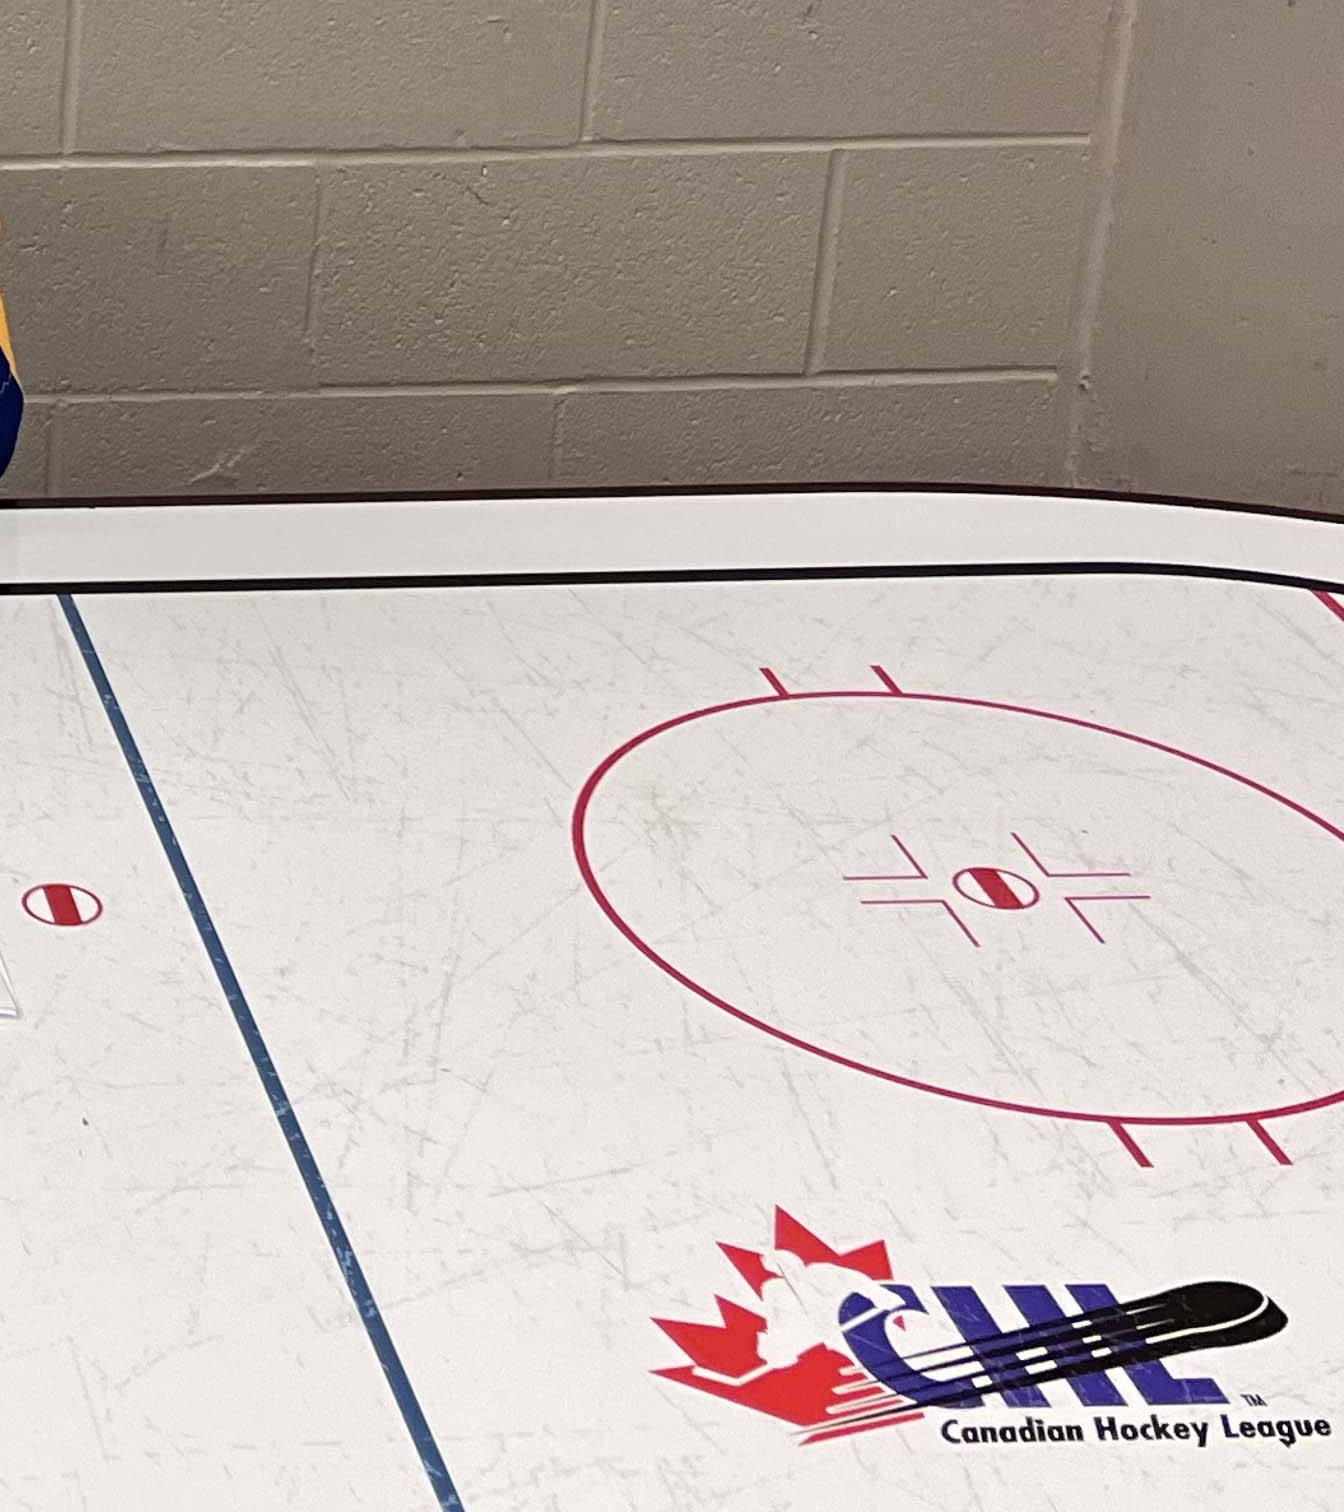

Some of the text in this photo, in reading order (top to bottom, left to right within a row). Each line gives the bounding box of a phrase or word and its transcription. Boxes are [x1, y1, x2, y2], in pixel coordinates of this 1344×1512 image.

[837, 1284, 1230, 1409] CHL
[940, 1414, 1332, 1449] Canadian Hockey League
